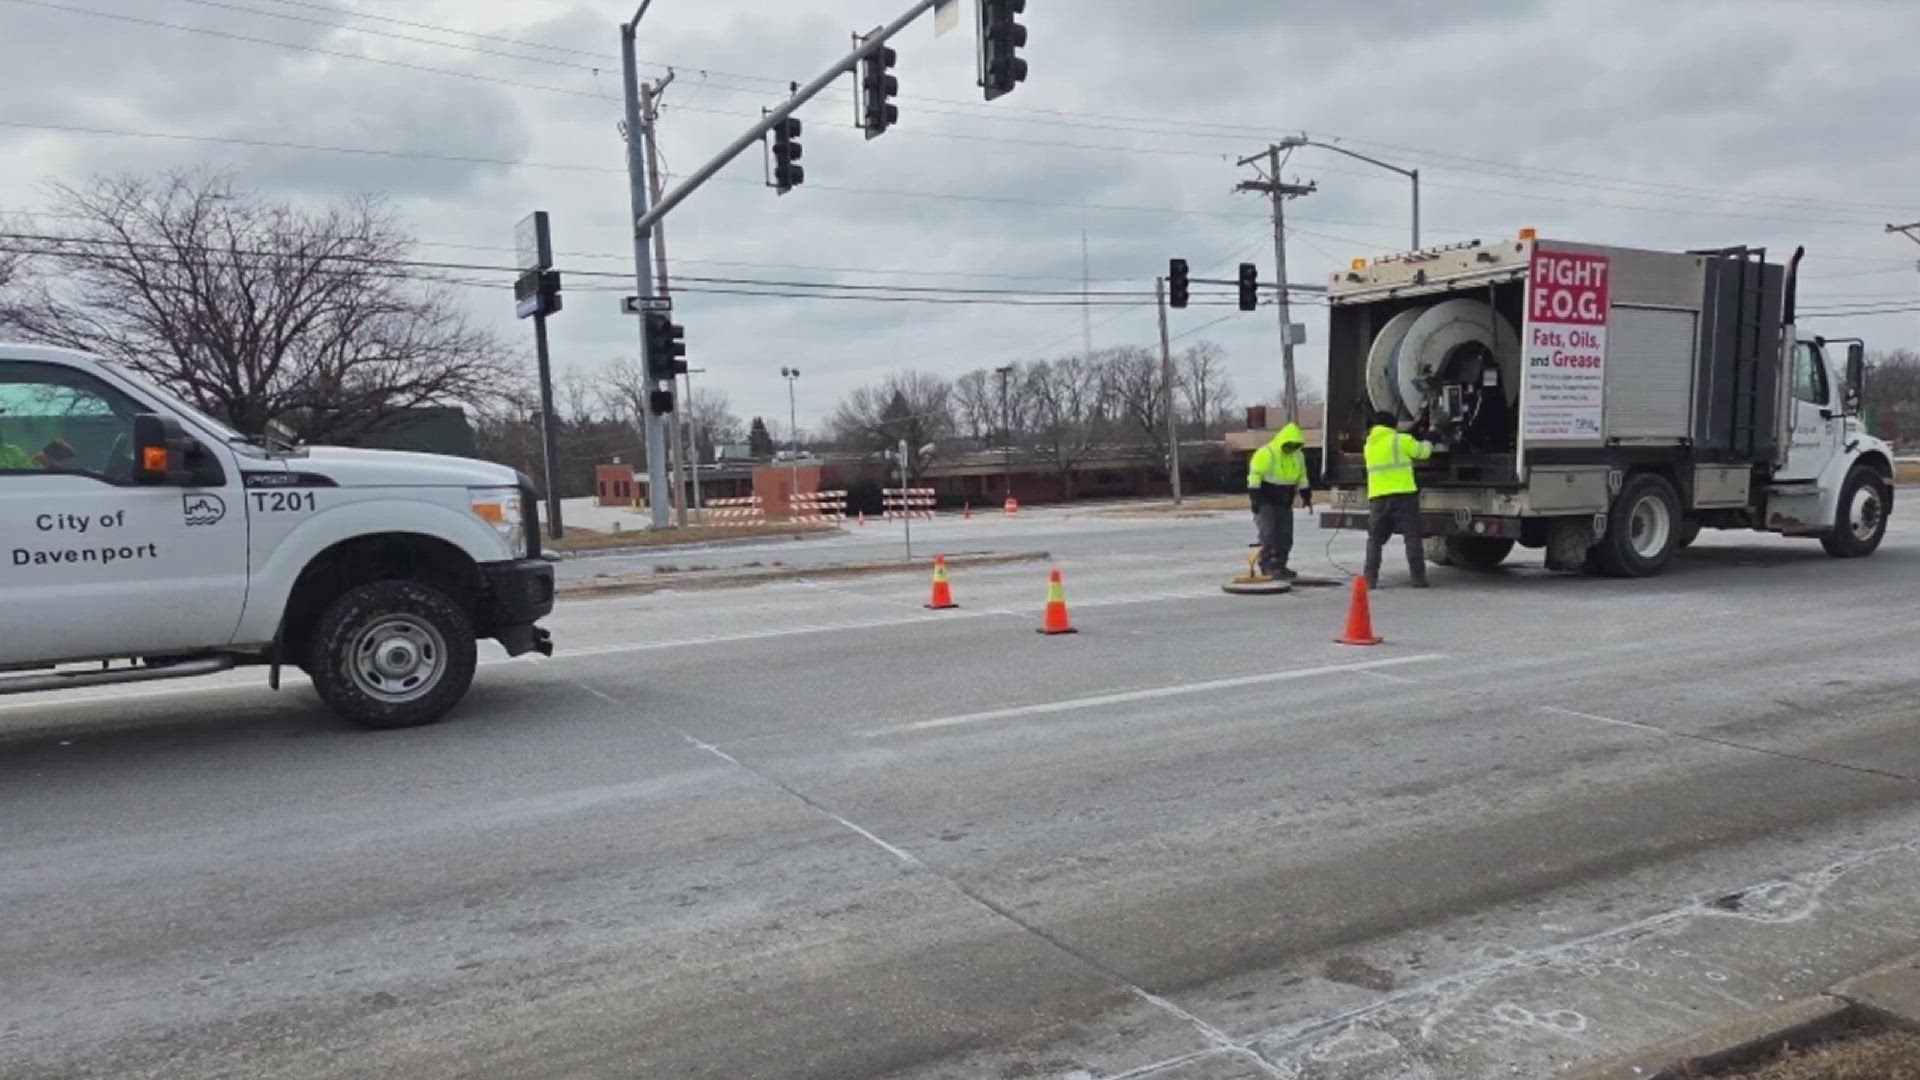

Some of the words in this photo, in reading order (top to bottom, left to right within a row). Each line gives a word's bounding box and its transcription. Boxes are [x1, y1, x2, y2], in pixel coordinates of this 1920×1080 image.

[1536, 256, 1607, 287] FIGHT
[1534, 288, 1603, 320] F.O.G.
[1533, 328, 1566, 348] Fats,
[1569, 330, 1601, 350] Oils,
[1530, 355, 1550, 367] and
[1552, 350, 1601, 368] Grease
[250, 491, 317, 512] T201
[36, 513, 90, 532] City
[99, 510, 125, 528] of
[12, 543, 158, 565] Davenport
